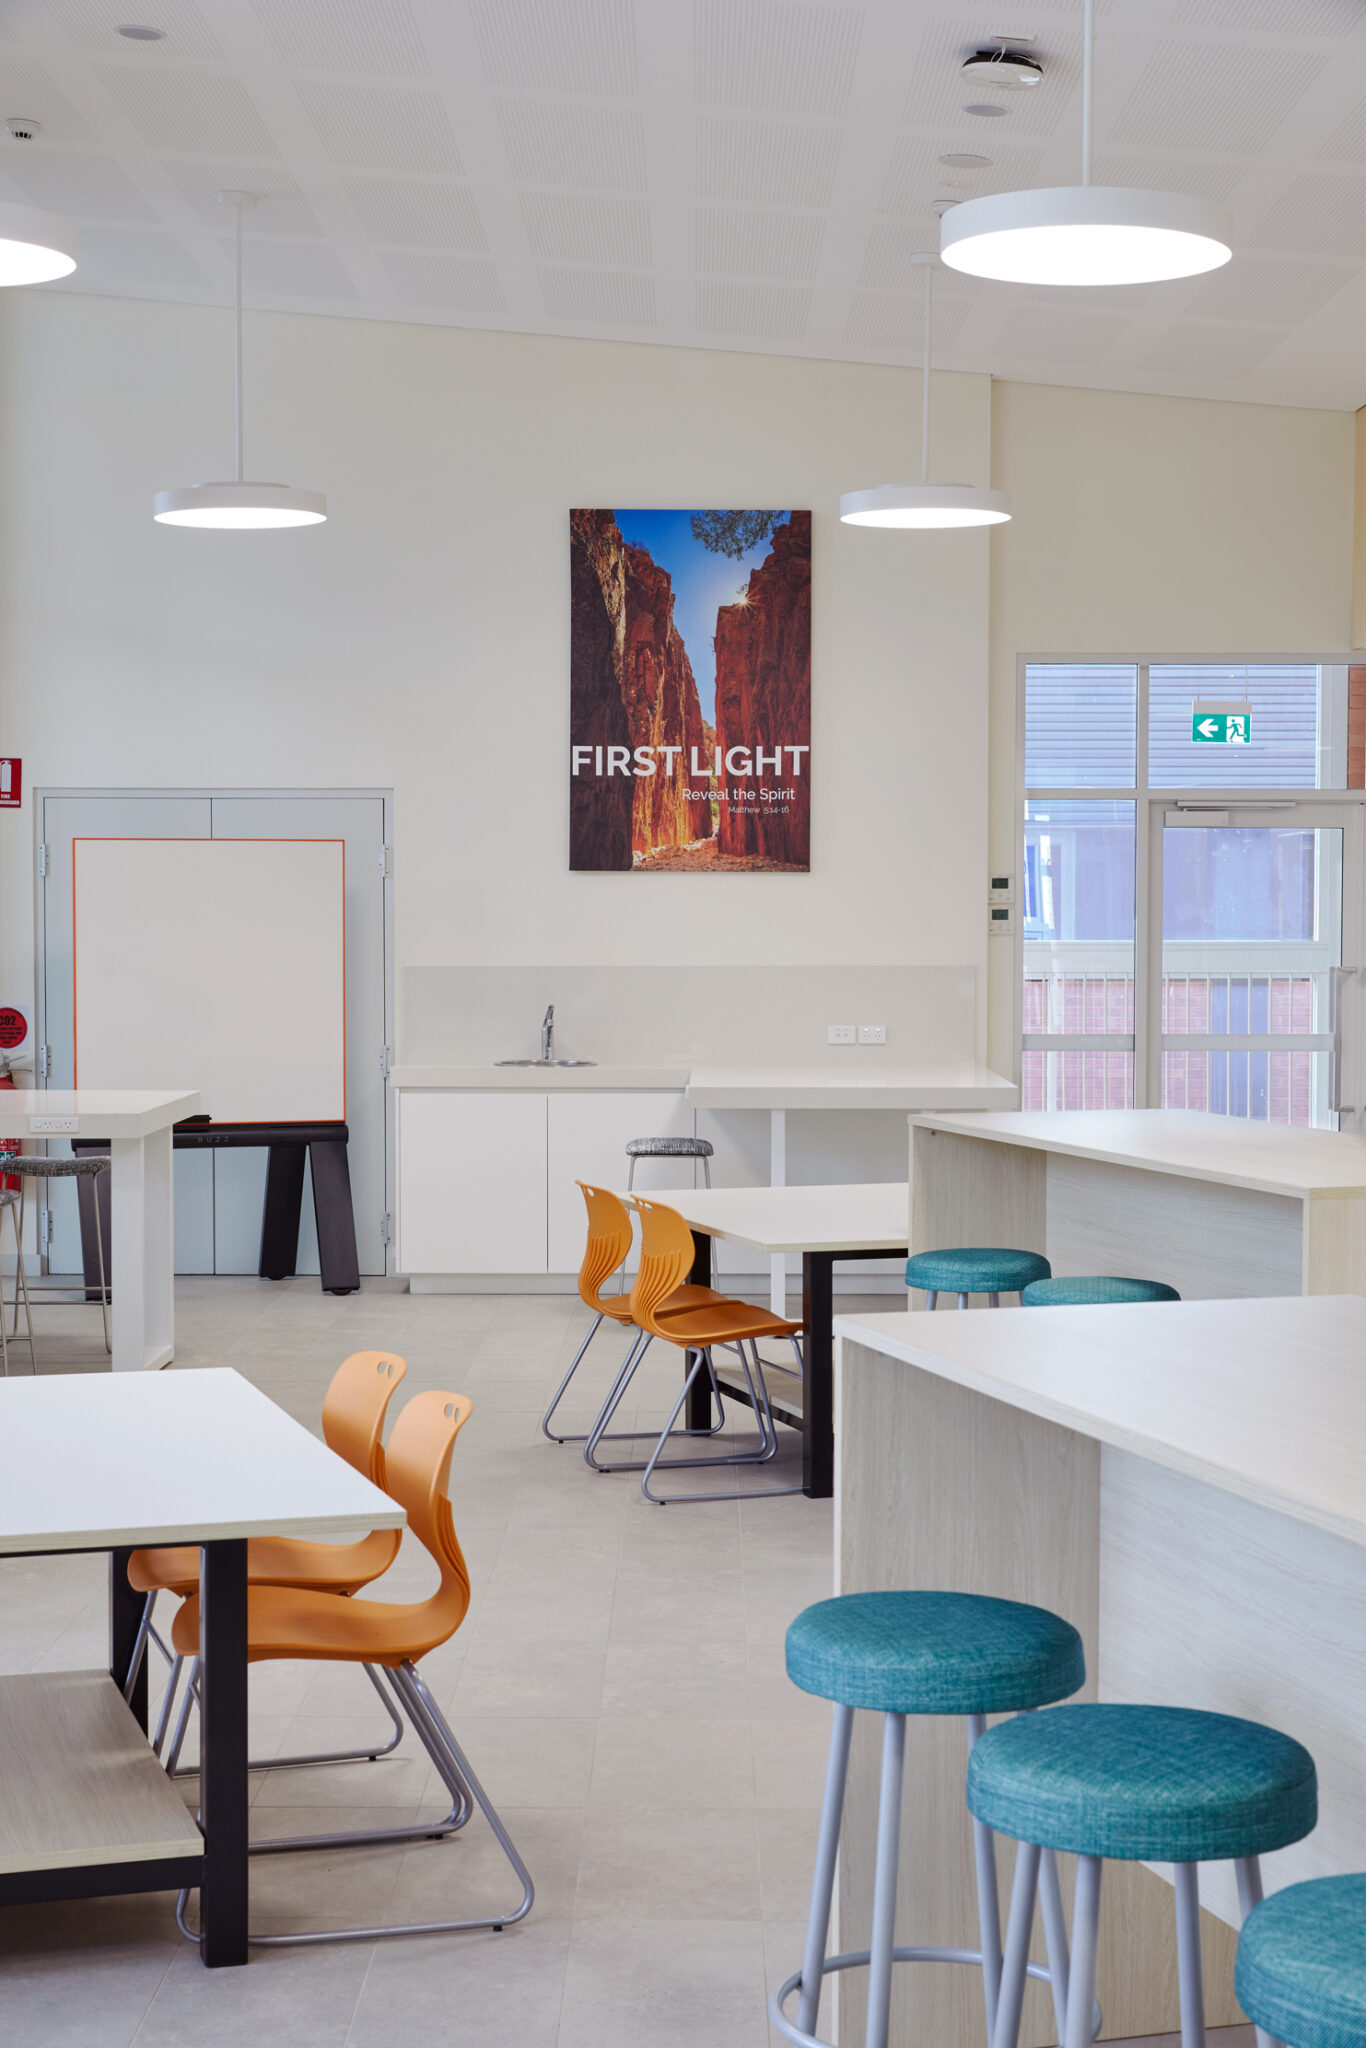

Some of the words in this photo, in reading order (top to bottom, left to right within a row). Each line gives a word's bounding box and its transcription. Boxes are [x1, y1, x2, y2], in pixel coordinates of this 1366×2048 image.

[572, 745, 682, 776] FIRST
[691, 745, 810, 776] LIGHT
[682, 788, 730, 801] Reveal
[732, 788, 756, 801] the
[759, 788, 796, 803] Spirit
[728, 806, 761, 814] Matthew
